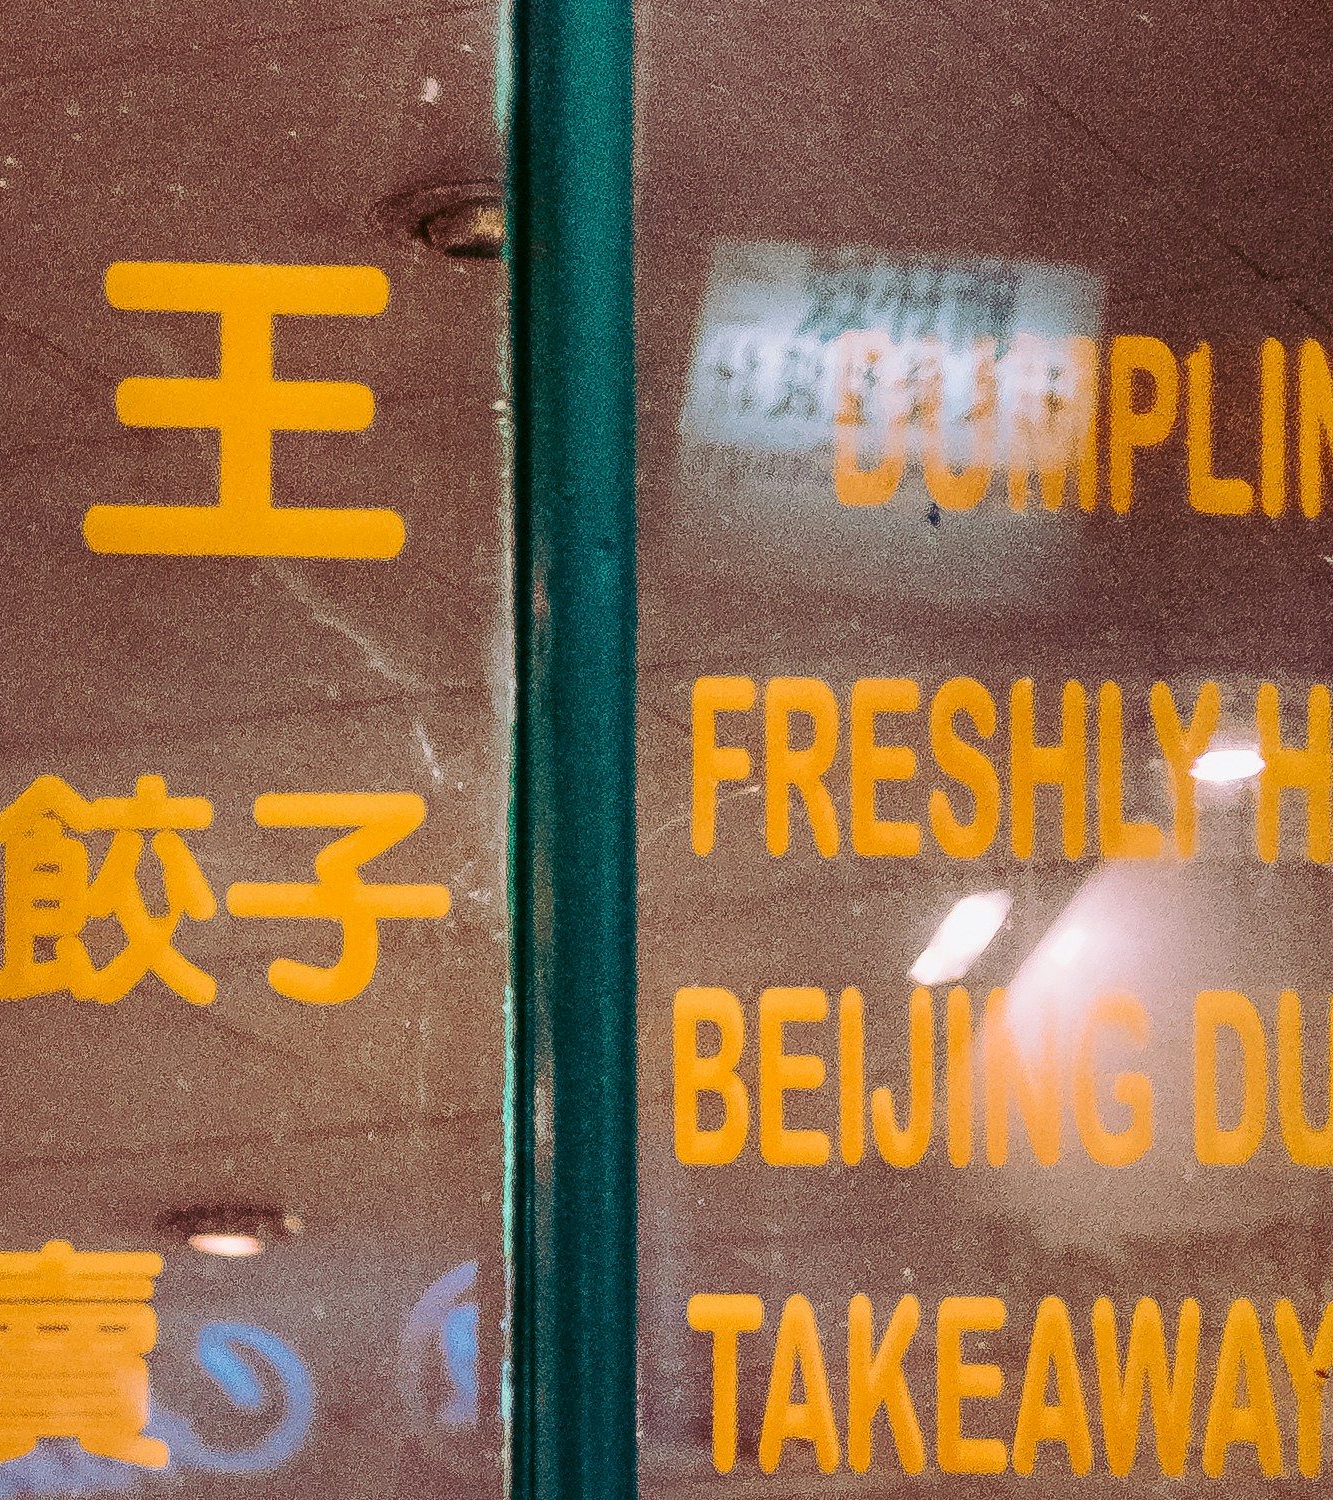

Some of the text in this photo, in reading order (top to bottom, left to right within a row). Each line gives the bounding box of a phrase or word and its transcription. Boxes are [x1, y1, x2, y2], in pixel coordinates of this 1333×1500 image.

[691, 677, 1220, 859] FRESHLY
[672, 987, 1152, 1167] BEIJING
[687, 1294, 1333, 1479] TAKEAWAY
